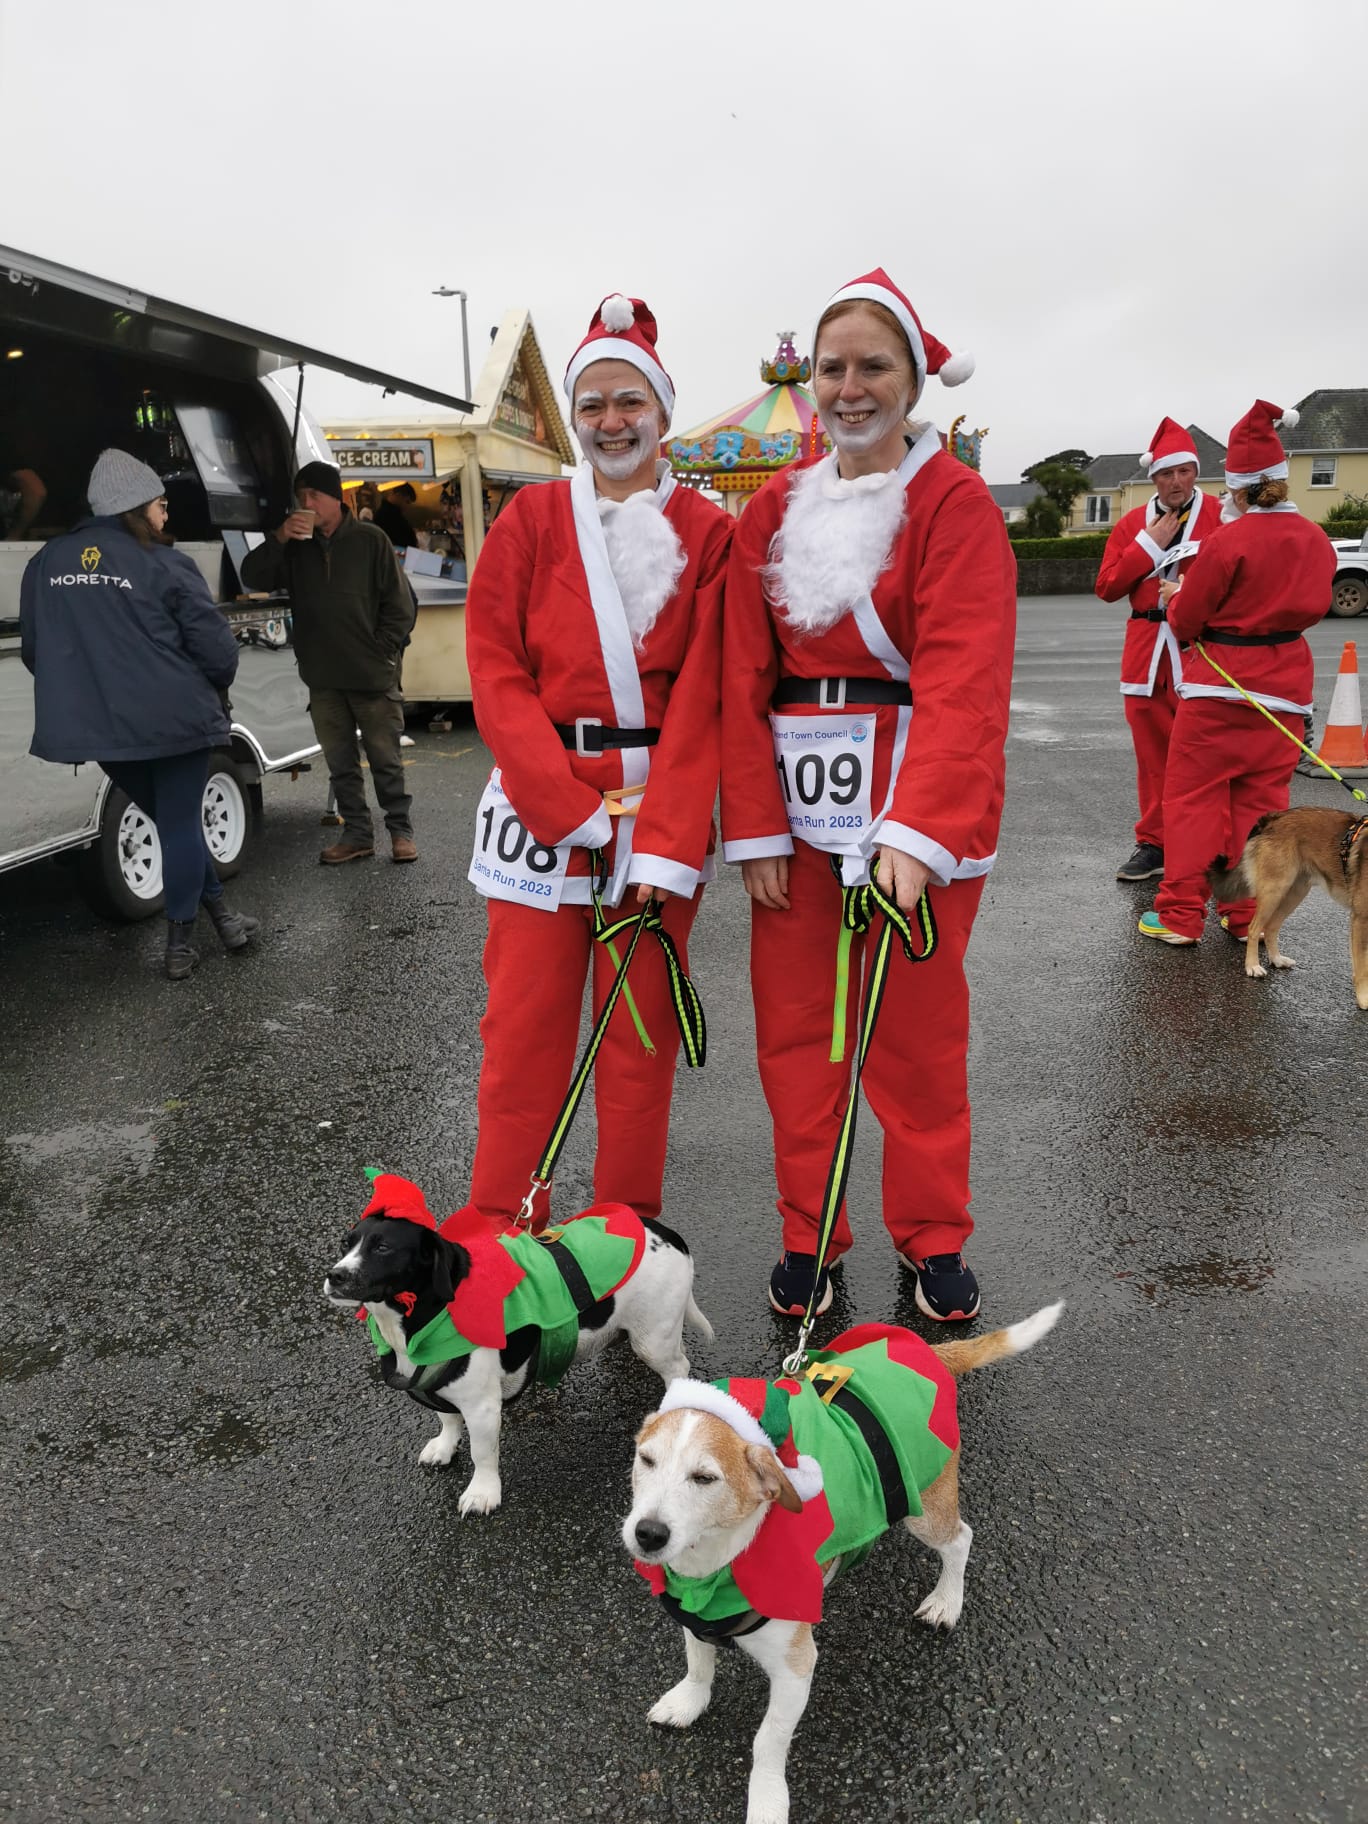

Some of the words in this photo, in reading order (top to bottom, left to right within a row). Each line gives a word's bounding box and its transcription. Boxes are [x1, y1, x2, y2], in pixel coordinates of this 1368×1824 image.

[50, 573, 133, 590] MORETTA
[790, 731, 813, 740] Town
[814, 730, 848, 739] Council
[777, 752, 863, 806] 109
[804, 815, 825, 829] Run
[829, 815, 863, 828] 2023
[482, 806, 558, 874] 108
[473, 858, 491, 879] Santa
[492, 869, 516, 888] Run
[519, 879, 553, 897] 2023
